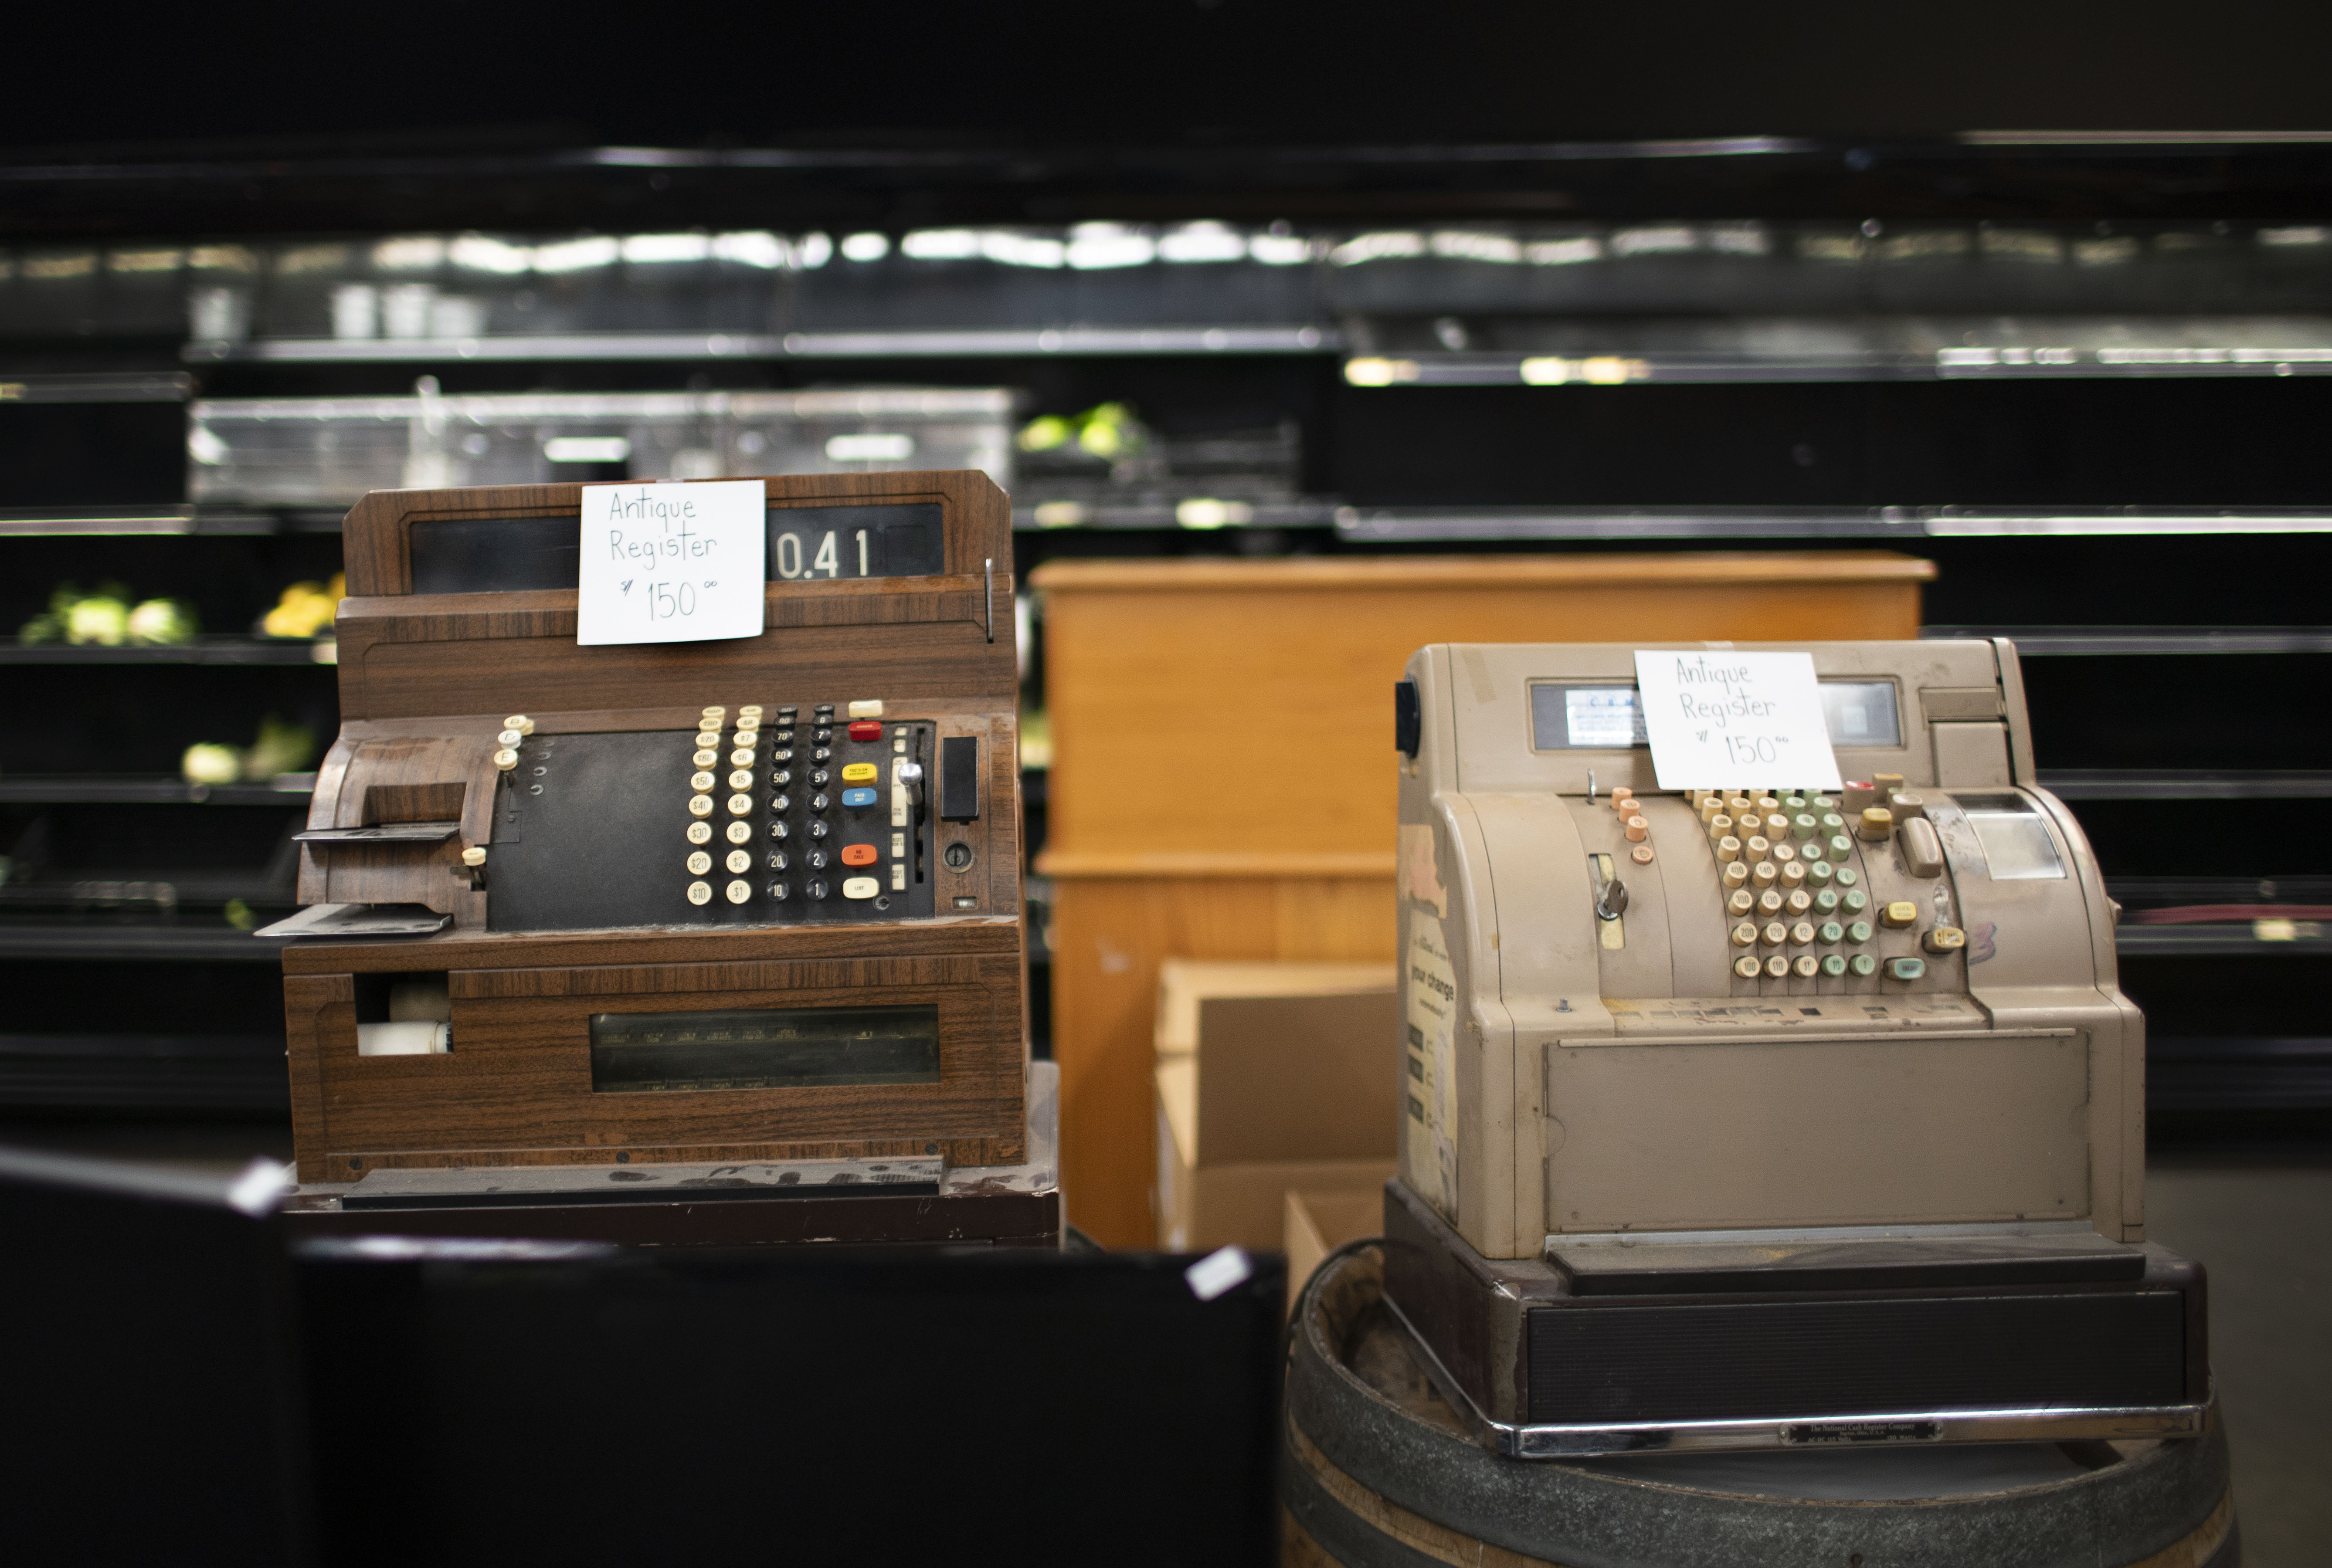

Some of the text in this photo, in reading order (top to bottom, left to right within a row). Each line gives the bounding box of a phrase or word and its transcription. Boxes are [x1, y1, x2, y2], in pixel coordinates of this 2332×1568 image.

[610, 488, 696, 532] Antique
[611, 521, 717, 570] Register
[1677, 656, 1752, 694] Antique
[1680, 688, 1776, 728] Register
[775, 751, 785, 760] 60
[816, 750, 821, 759] 6
[695, 777, 709, 786] $50
[736, 775, 746, 783] $5
[774, 774, 784, 782] 50
[815, 773, 821, 783] 5
[693, 800, 708, 809] $40
[734, 800, 744, 809] $4
[772, 799, 783, 809] 40
[813, 796, 820, 807] 4
[692, 828, 706, 838] $30
[733, 828, 743, 837] $3
[772, 825, 782, 836] 30
[813, 824, 819, 836] 3
[691, 858, 706, 869] $20
[733, 857, 743, 867] $2
[771, 855, 782, 867] 20
[813, 853, 819, 866] 2
[692, 888, 706, 899] $10
[734, 887, 743, 897] $1
[774, 885, 782, 897] 10
[815, 884, 818, 896] 1
[1765, 895, 1778, 904] $30
[1796, 895, 1804, 904] $3
[1741, 928, 1754, 937] 200
[1770, 927, 1782, 937] $20
[1800, 927, 1808, 937] $2
[1828, 927, 1838, 936] 20
[1859, 926, 1865, 937] 2
[1745, 962, 1756, 971] 100
[1773, 961, 1783, 971] $10
[1804, 961, 1811, 971] $1
[1833, 960, 1840, 970] 10
[1864, 960, 1867, 969] 1
[1427, 972, 1454, 1001] change
